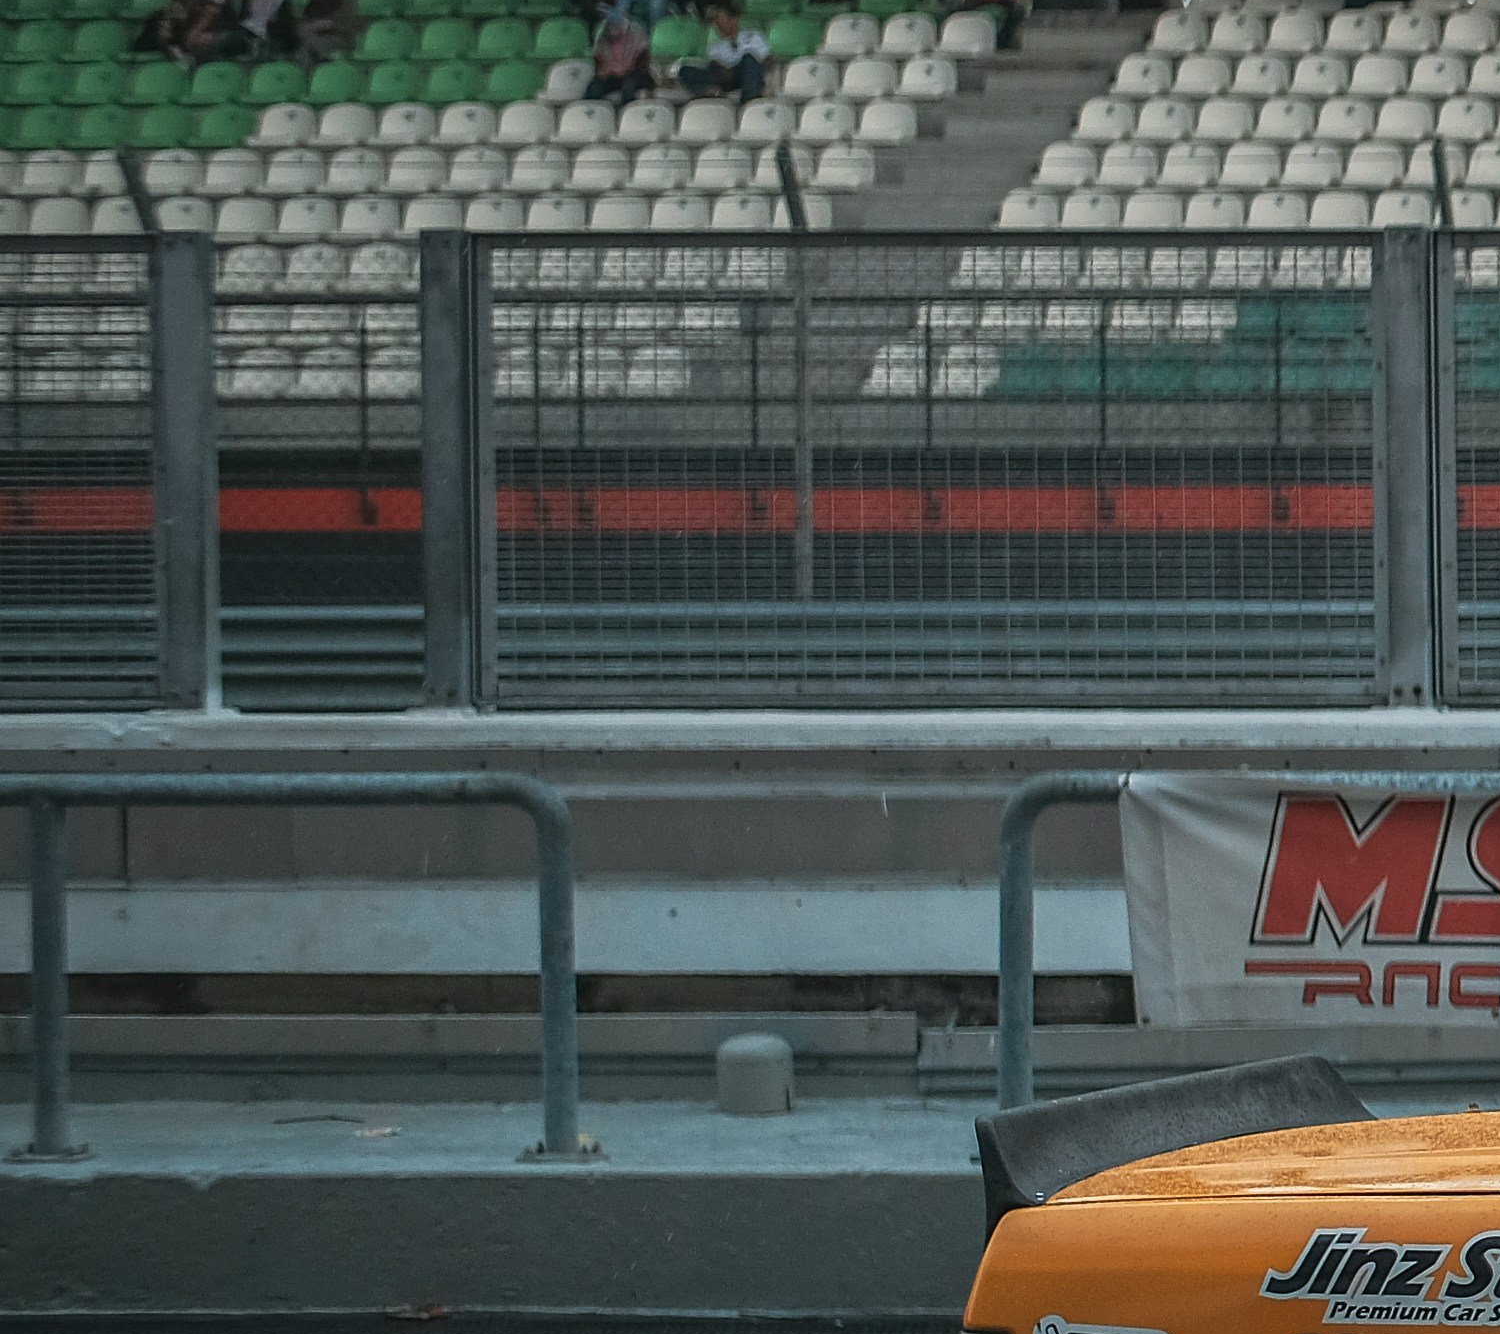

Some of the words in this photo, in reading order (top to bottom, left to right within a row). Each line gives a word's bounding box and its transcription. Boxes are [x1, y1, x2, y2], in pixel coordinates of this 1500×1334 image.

[1265, 1232, 1442, 1297] Jinz
[1329, 1301, 1438, 1323] Premium
[1444, 1303, 1484, 1323] Car
